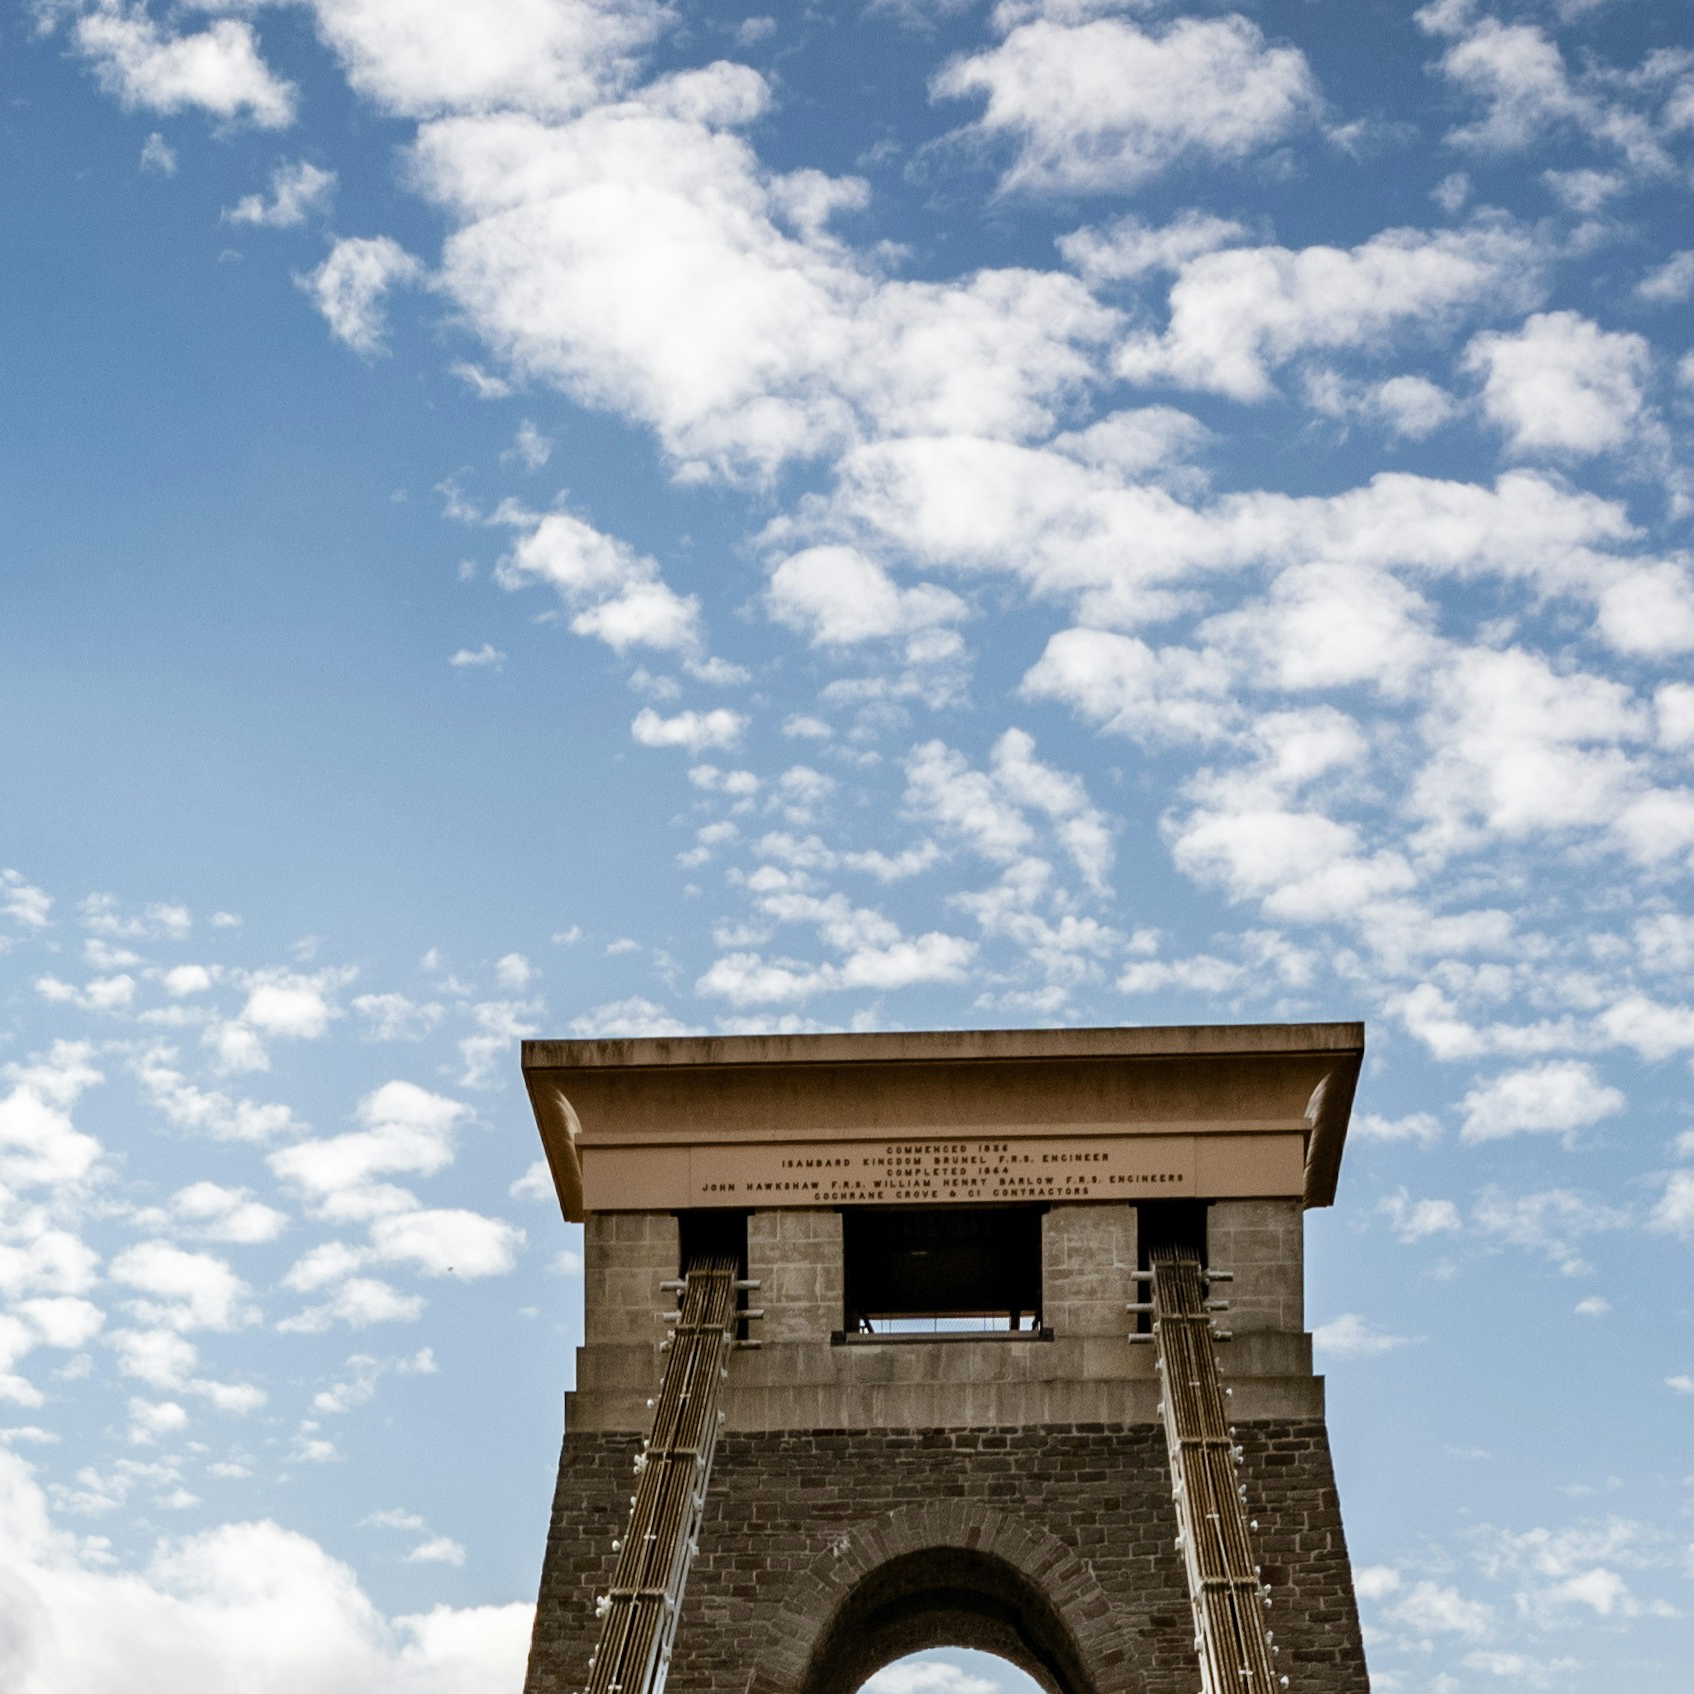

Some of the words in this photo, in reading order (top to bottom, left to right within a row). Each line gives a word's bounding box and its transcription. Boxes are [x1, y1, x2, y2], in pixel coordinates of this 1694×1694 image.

[886, 1145, 967, 1155] COMMENCED
[781, 1158, 851, 1168] ISAMBARD
[862, 1157, 922, 1167] KINGDOM
[933, 1156, 987, 1166] BRUNEL
[998, 1154, 1035, 1164] F.R.S.
[1042, 1153, 1110, 1163] ENGINEER
[886, 1166, 967, 1177] COMPLETED
[978, 1166, 1009, 1175] 1864
[701, 1183, 736, 1192] JOHN
[746, 1181, 820, 1191] HAWKSHAW
[831, 1180, 867, 1190] F.R.S.
[873, 1179, 932, 1188] WILLIAM
[943, 1177, 988, 1187] HENRY
[999, 1176, 1054, 1186] BARLOW
[1066, 1175, 1102, 1185] F.R.S.
[1109, 1174, 1184, 1184] ENGINEERS
[814, 1191, 884, 1201] COCHRANE
[949, 1190, 957, 1198] &
[992, 1187, 1090, 1197] CONTRACTORS
